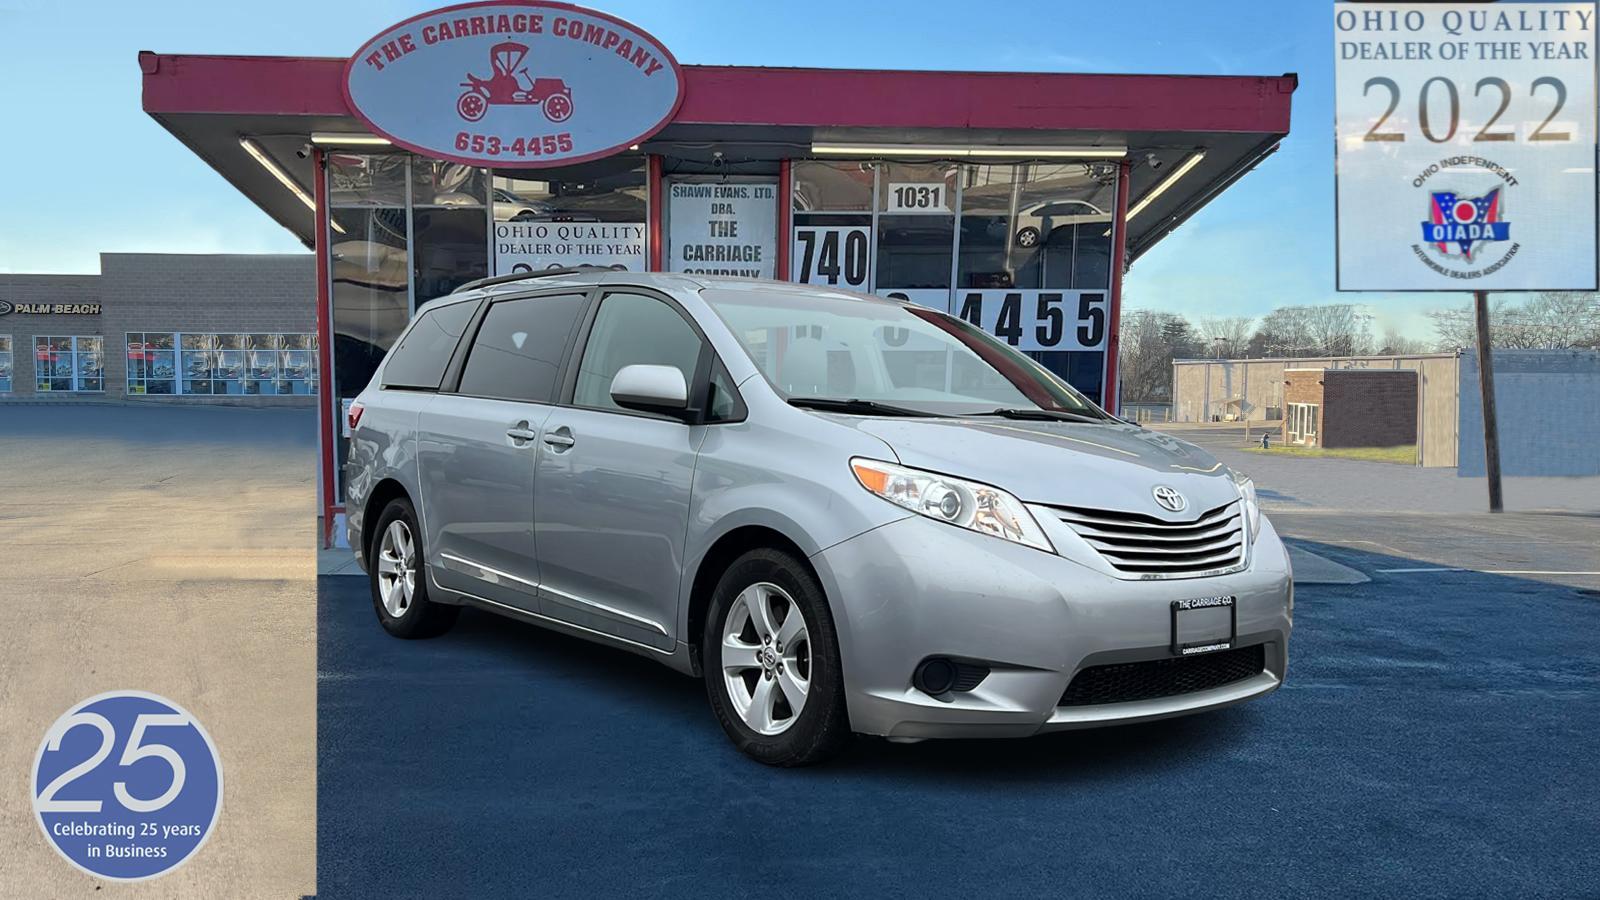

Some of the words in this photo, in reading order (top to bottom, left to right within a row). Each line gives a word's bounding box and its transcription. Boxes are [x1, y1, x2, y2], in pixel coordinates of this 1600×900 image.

[1336, 10, 1425, 31] OHIO
[1442, 10, 1593, 36] QUALITY
[366, 33, 416, 72] THE
[422, 14, 544, 46] CARRIAGE
[553, 17, 664, 77] COMPANY
[1340, 42, 1433, 60] DEALER
[1439, 42, 1470, 60] OF
[1475, 42, 1522, 60] THE
[1528, 41, 1589, 60] YEAR
[1363, 76, 1571, 143] 2022
[454, 131, 574, 157] 653-4455
[1412, 164, 1439, 188] OHIO
[1440, 156, 1519, 187] INDEPENDENT
[673, 186, 712, 198] SHAWN
[894, 186, 941, 209] 1031
[497, 226, 548, 239] OHIO
[557, 226, 643, 241] QUALITY
[708, 220, 738, 238] THE
[1432, 224, 1495, 241] OIADA
[499, 243, 552, 255] DEALER
[555, 244, 574, 255] OF
[576, 244, 603, 255] THE
[606, 244, 642, 256] YEAR
[683, 244, 762, 262] CARRIAGE
[797, 229, 869, 287] 740
[1449, 270, 1482, 280] DEALERS
[15, 304, 50, 314] PALM
[54, 304, 100, 314] BEACH
[1180, 600, 1192, 609] THE
